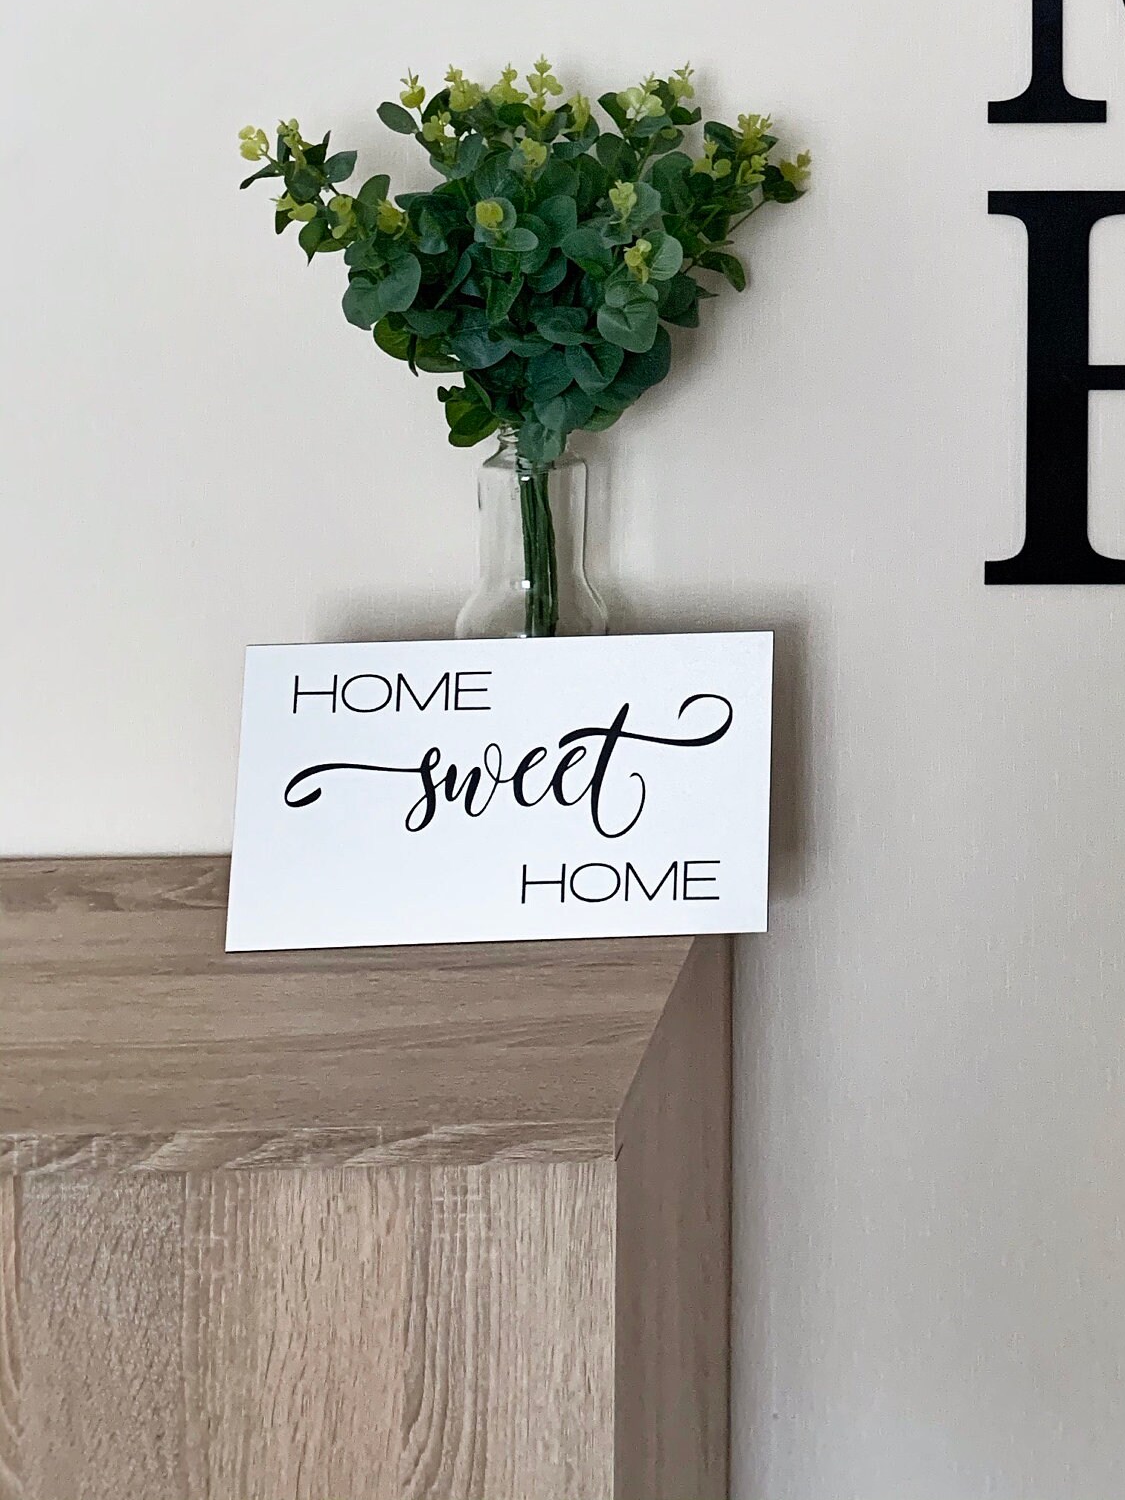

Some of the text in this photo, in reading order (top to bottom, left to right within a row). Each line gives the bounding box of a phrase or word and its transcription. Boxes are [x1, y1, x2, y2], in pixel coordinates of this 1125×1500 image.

[291, 670, 493, 714] HOME
[284, 693, 734, 839] sweet
[520, 859, 721, 905] HOME
